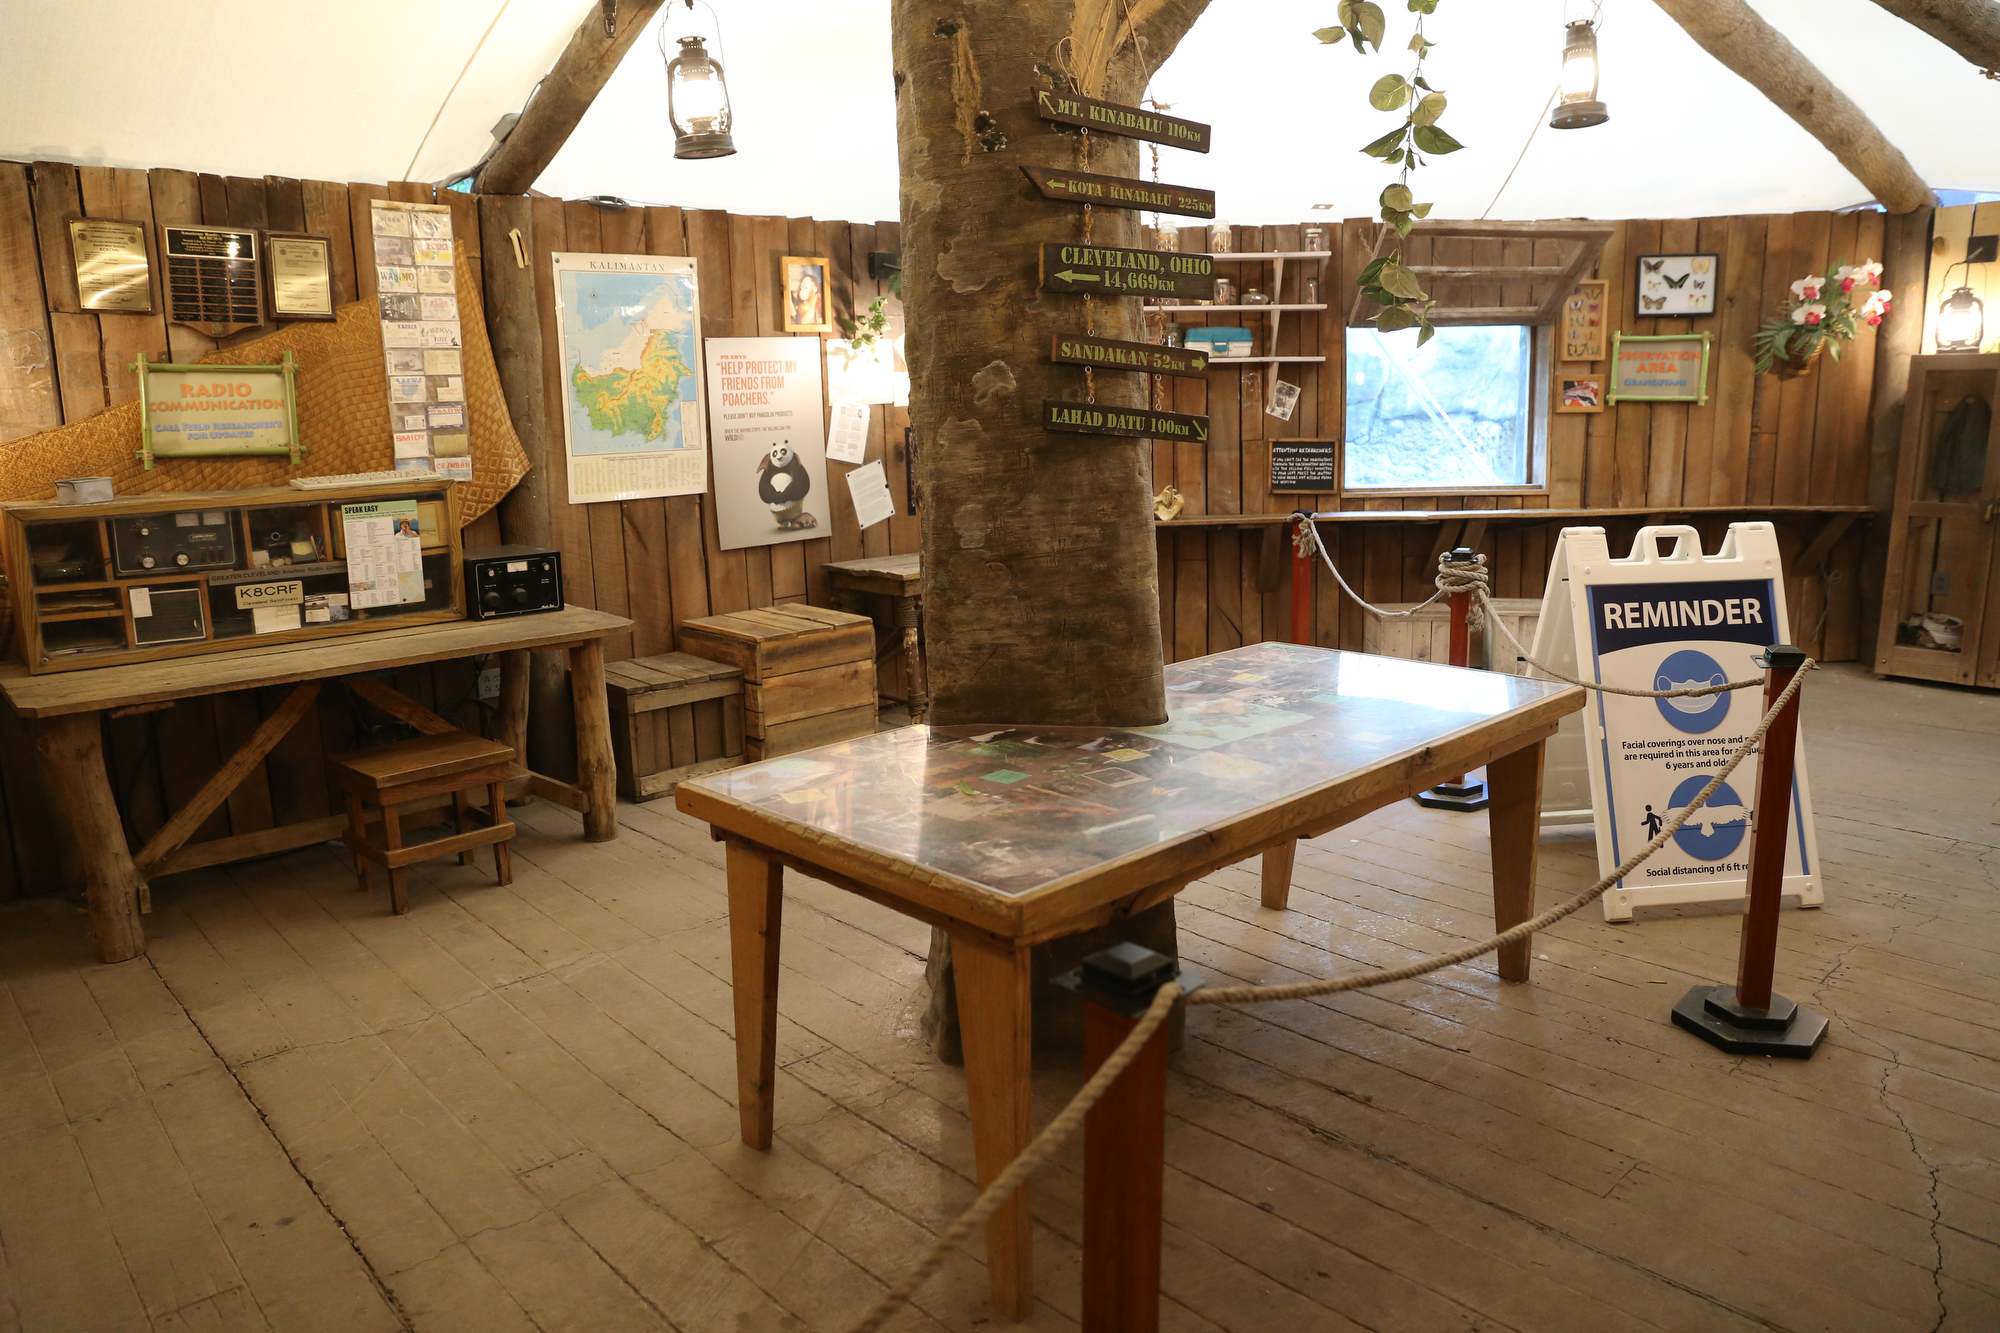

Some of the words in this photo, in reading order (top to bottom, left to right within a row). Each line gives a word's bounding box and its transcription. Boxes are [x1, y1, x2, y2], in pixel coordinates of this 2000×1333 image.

[1058, 99, 1084, 117] MT.
[1090, 105, 1162, 133] KINABALU
[1068, 180, 1102, 196] KOTA
[1110, 186, 1171, 206] KINABALU
[589, 261, 664, 272] KALIMANTAN
[1061, 247, 1165, 274] CLEVELAND,
[1170, 257, 1212, 275] OHIO
[1062, 342, 1148, 366] SANDAKAN
[1618, 351, 1701, 360] OBSERVATION
[746, 361, 782, 374] PROTECT
[785, 361, 798, 373] MY
[1636, 362, 1677, 373] AREA
[722, 377, 758, 390] FRIENDS
[761, 376, 784, 389] FROM
[181, 383, 252, 398] RADIO
[150, 399, 284, 412] COMMUNICATION
[1052, 408, 1103, 426] LAHAD
[1107, 414, 1145, 430] DATU
[154, 424, 180, 432] CALL
[182, 423, 210, 431] FIELD
[187, 432, 208, 440] FOR
[209, 431, 254, 439] UPDATES
[345, 506, 363, 514] SPEAK
[243, 570, 279, 578] CLEVELAND
[240, 584, 298, 598] K8CRF
[1604, 598, 1763, 629] REMINDER
[1622, 740, 1645, 749] Facial
[1647, 739, 1685, 748] coverings
[1640, 749, 1674, 761] required
[1686, 748, 1700, 757] this
[1672, 761, 1694, 771] years
[1647, 867, 1670, 876] Social
[1673, 865, 1714, 875] distancing
